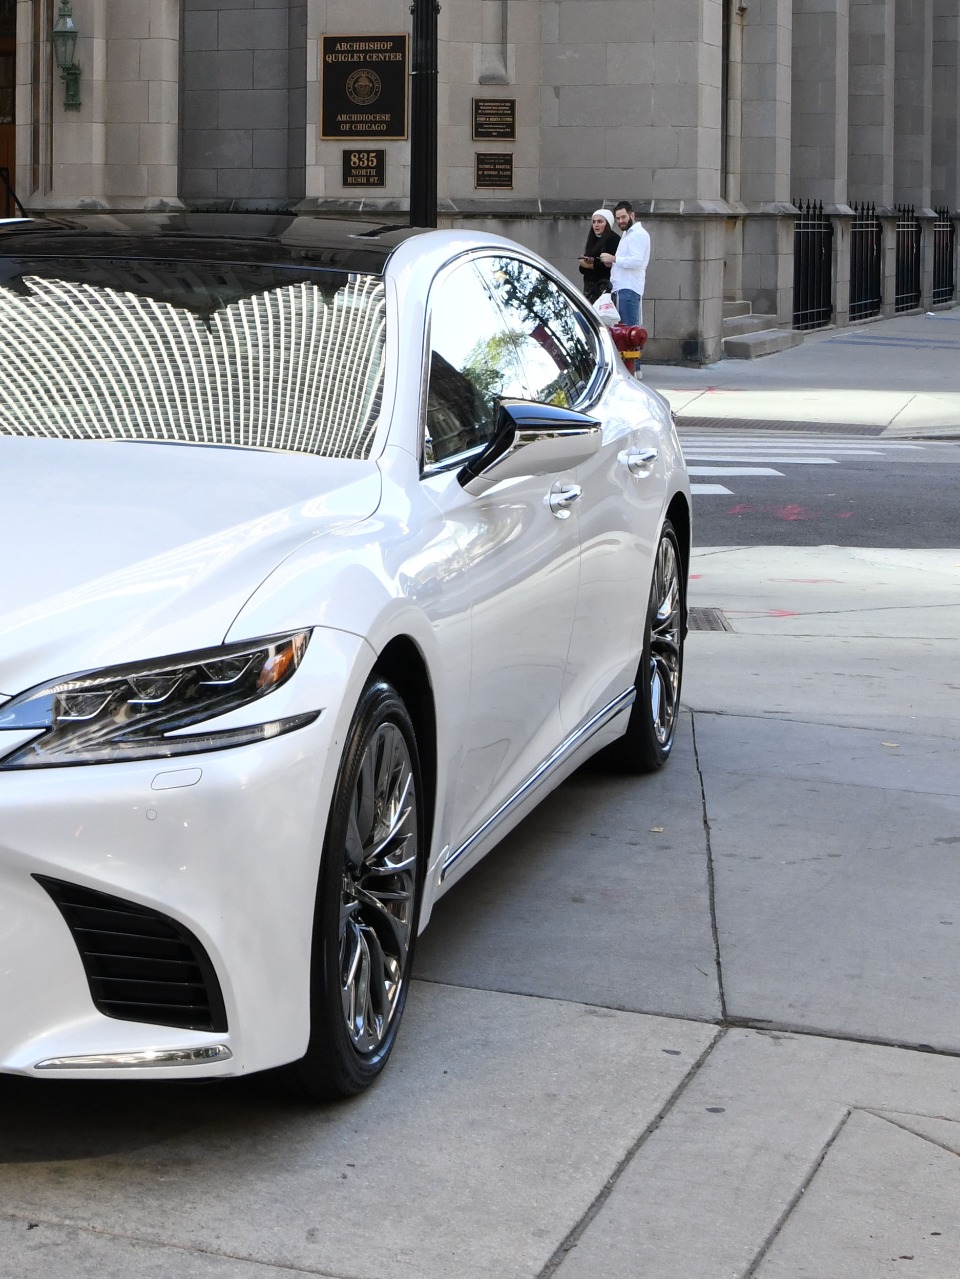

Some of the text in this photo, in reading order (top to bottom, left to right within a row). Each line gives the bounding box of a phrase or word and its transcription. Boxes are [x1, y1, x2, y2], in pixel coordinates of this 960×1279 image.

[335, 41, 394, 51] ARCHBISHOP
[325, 52, 403, 63] QUIGLEY CENTER
[336, 113, 391, 122] ARCHDIOCESE
[340, 123, 387, 131] OF CHICAGO
[350, 152, 377, 167] 835
[347, 176, 380, 184] RUSH ST.
